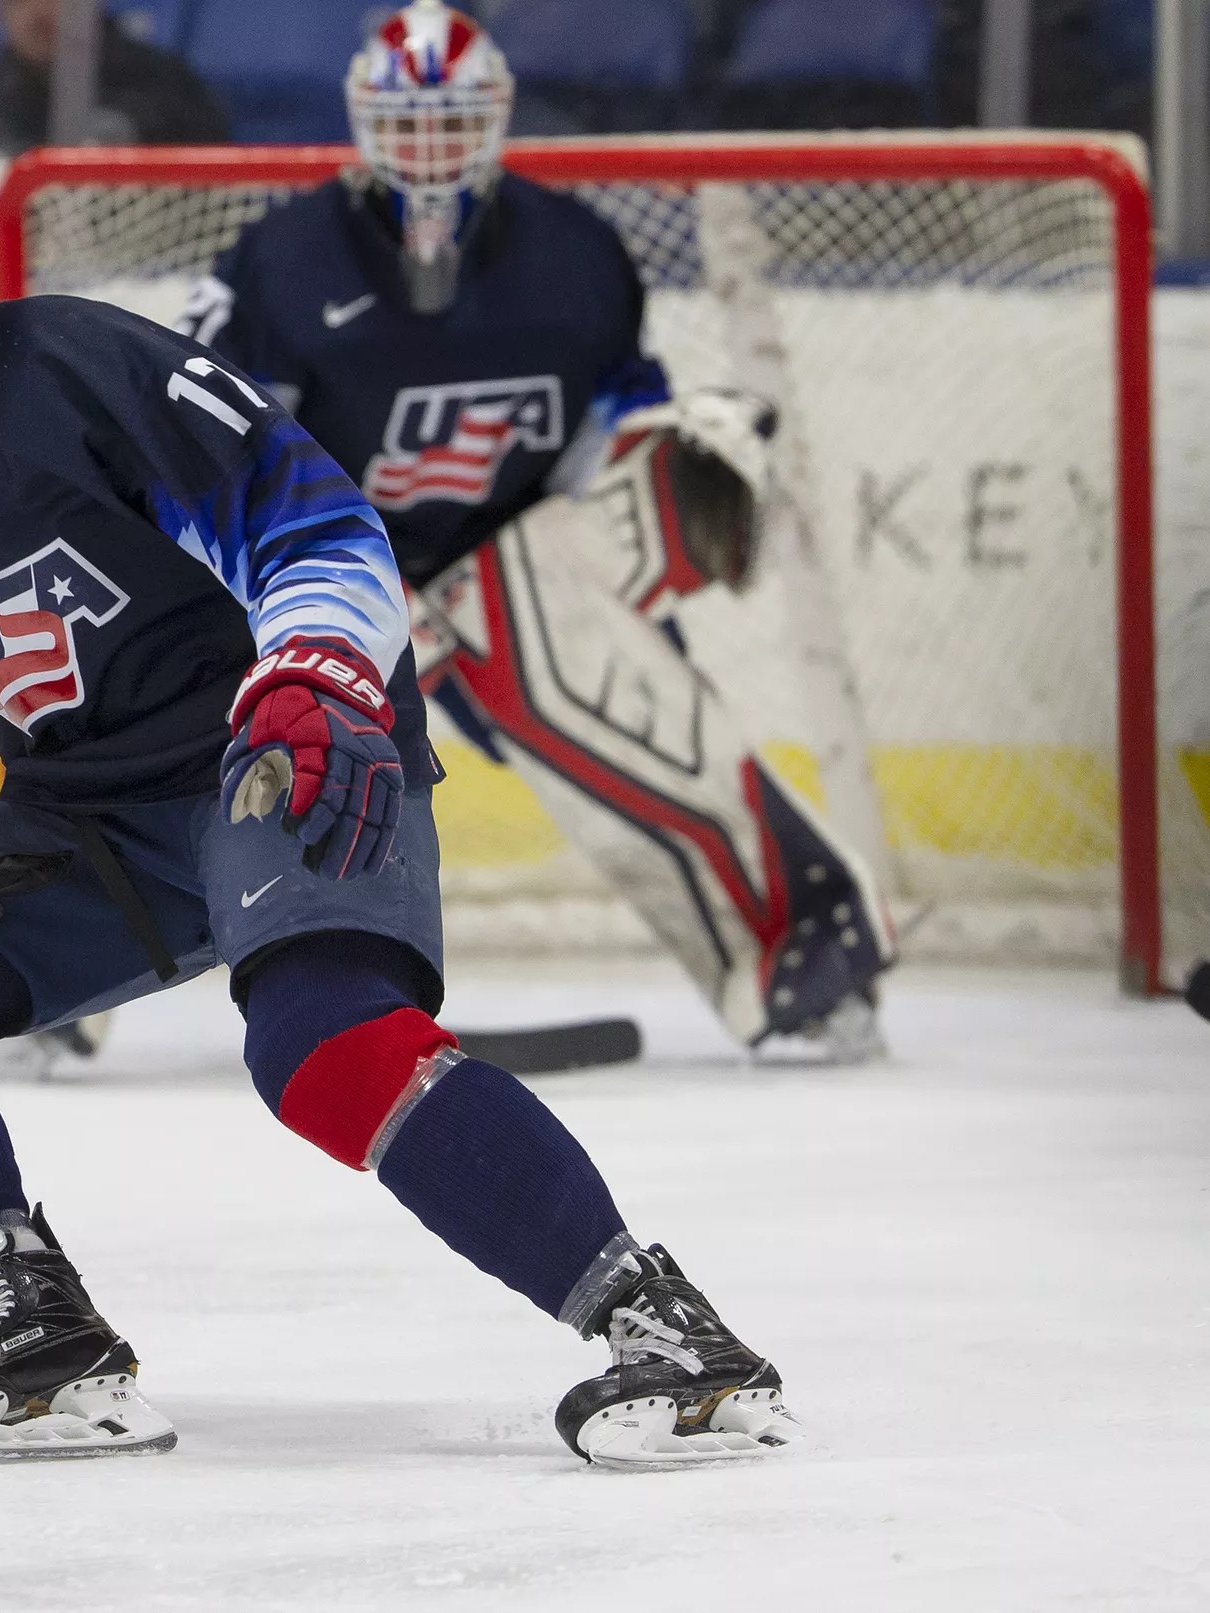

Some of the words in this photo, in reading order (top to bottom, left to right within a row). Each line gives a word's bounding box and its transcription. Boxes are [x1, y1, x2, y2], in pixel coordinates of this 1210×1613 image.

[167, 356, 269, 436] 17
[226, 649, 387, 724] AUER
[5, 1328, 41, 1350] BAUER
